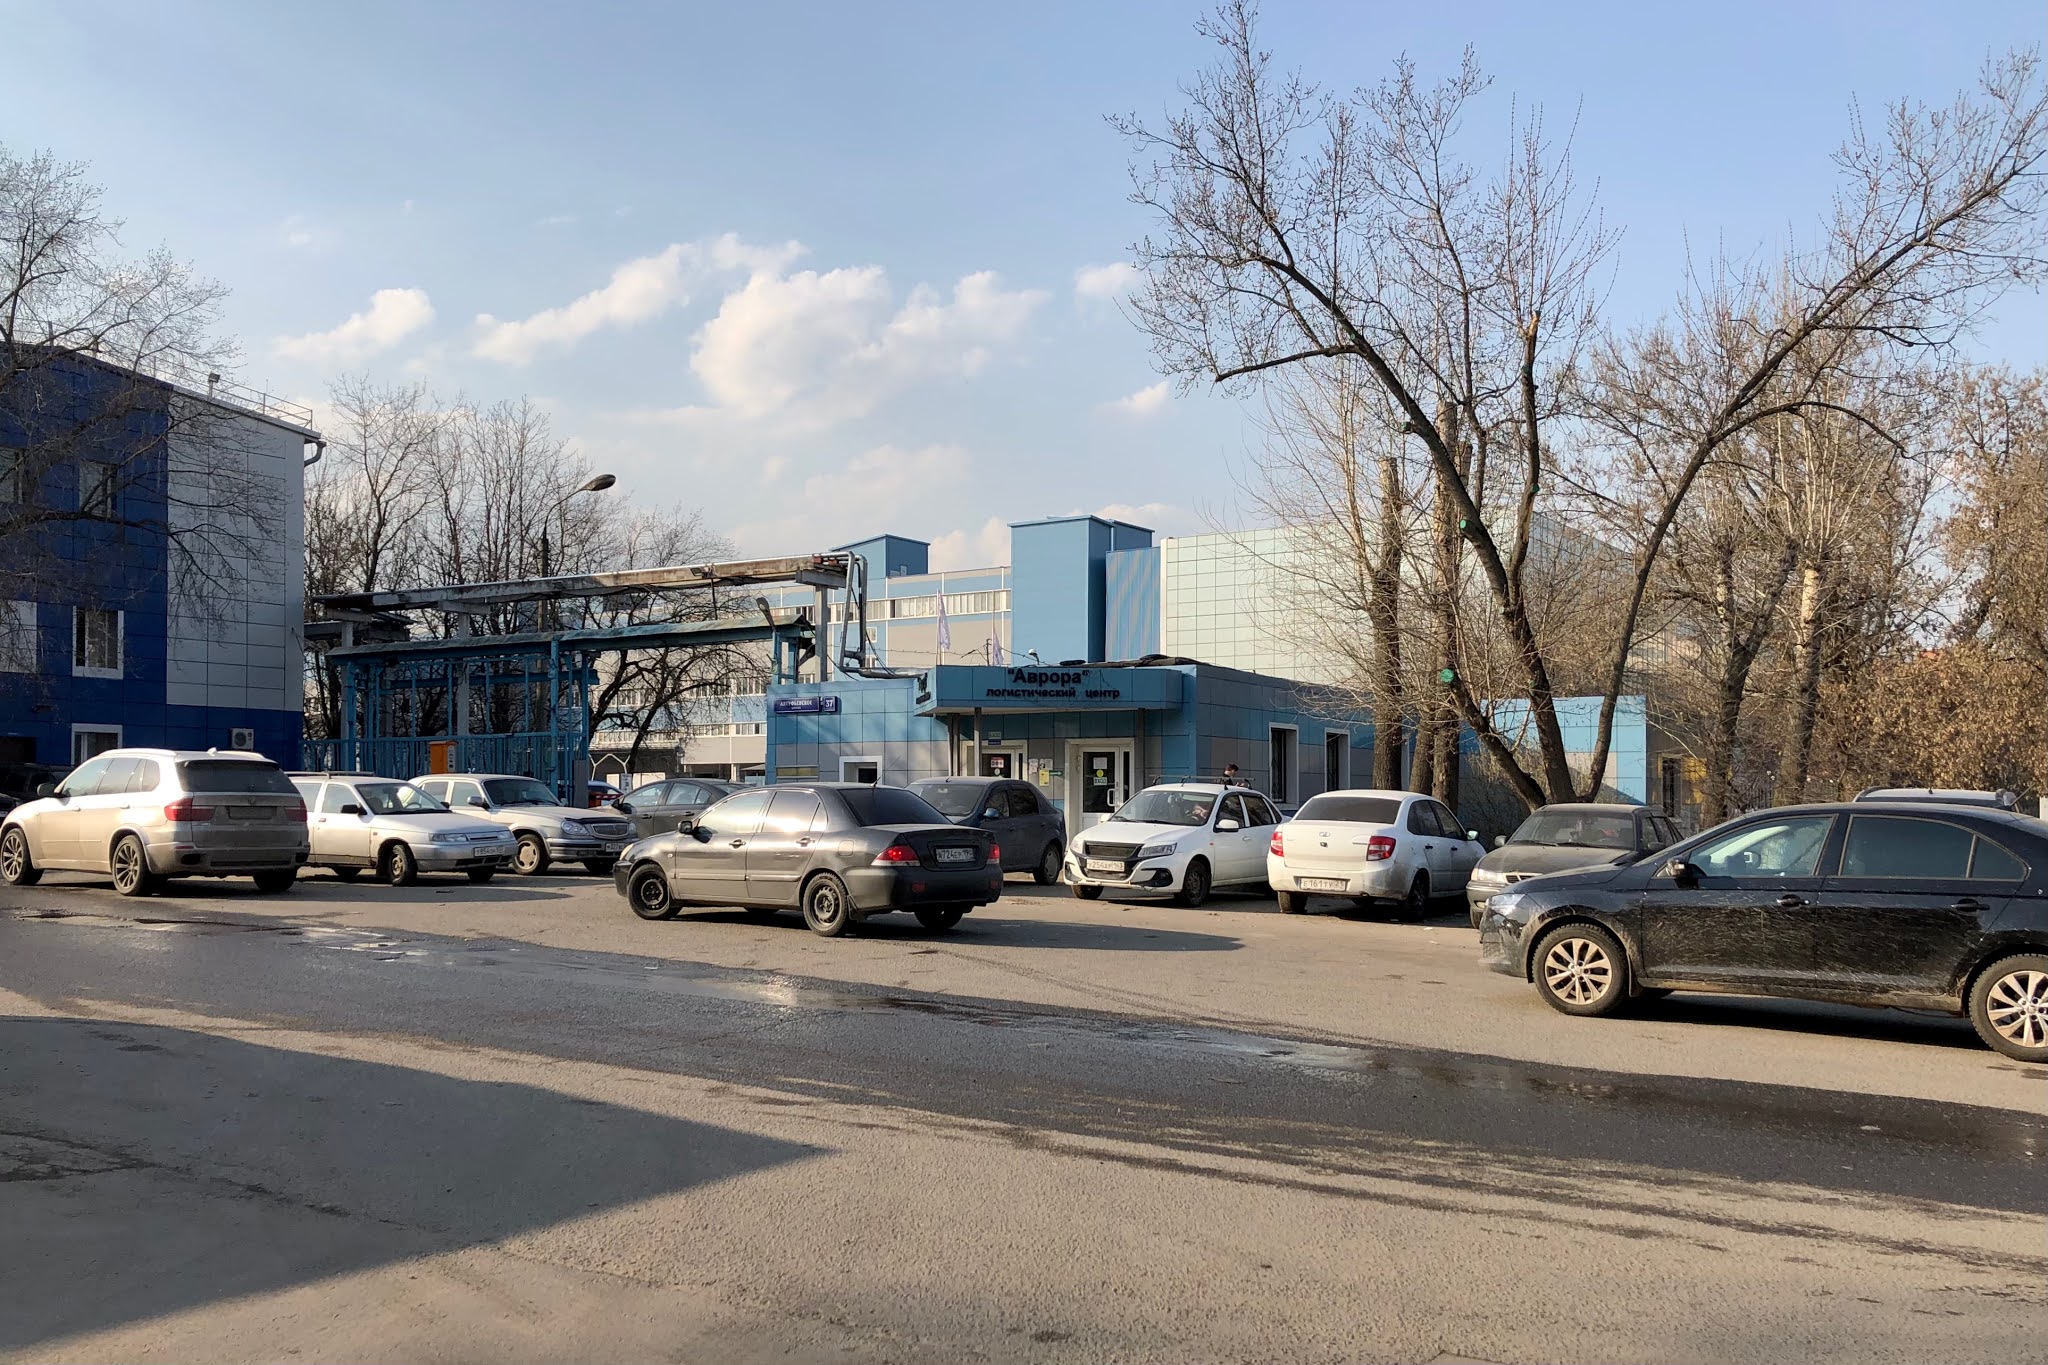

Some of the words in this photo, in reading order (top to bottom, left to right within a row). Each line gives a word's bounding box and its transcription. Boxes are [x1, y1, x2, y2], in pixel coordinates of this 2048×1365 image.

[1007, 668, 1090, 687] "Аврора"
[986, 687, 1076, 698] логистический
[1085, 688, 1120, 699] центр
